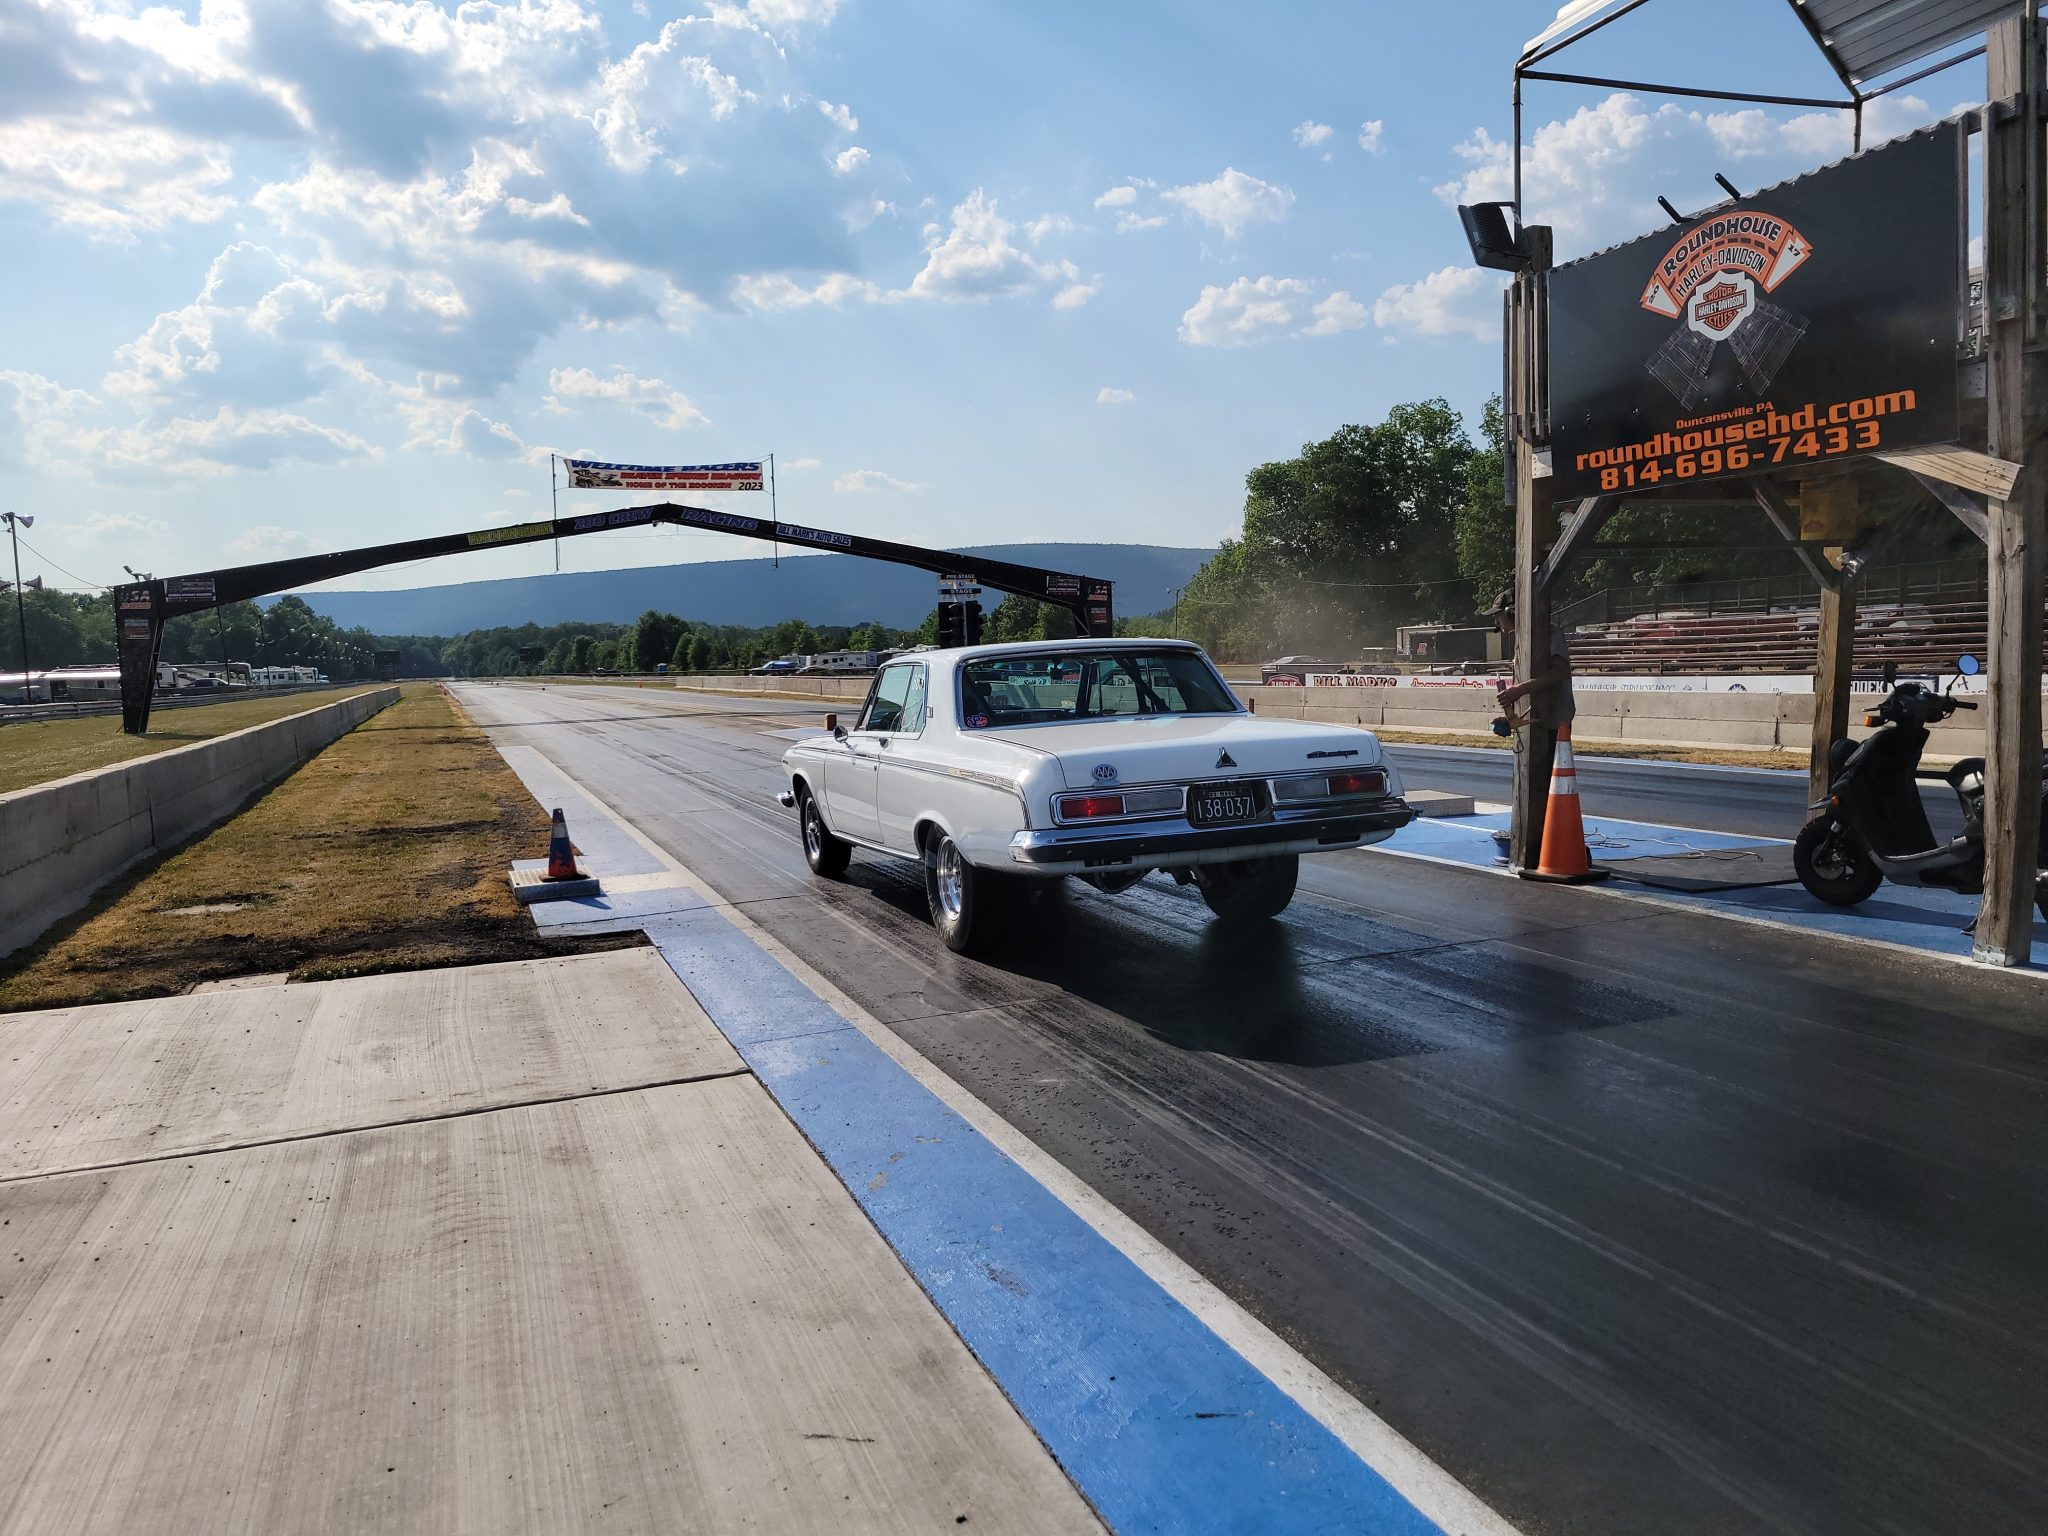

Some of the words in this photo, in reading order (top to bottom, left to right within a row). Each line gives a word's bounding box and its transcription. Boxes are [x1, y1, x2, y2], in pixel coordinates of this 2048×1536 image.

[1663, 216, 1782, 277] ROUNDHOUSE
[1675, 246, 1768, 298] HARLEY-DAVIDSON
[1698, 294, 1744, 317] HARLEY-DAVIDSON
[1708, 287, 1734, 301] MOTOR
[1708, 311, 1733, 328] CYCLES
[1675, 406, 1754, 430] Duncansville
[1756, 401, 1775, 415] PA
[1575, 388, 1916, 471] roundhousehd.com
[1600, 420, 1881, 491] 814-696-7433
[738, 481, 764, 491] 2023
[575, 515, 606, 530] ZOO
[608, 507, 655, 525] CREW
[681, 508, 759, 531] RACING
[814, 531, 832, 542] AUTO
[832, 534, 851, 546] SALES
[1097, 766, 1116, 778] AAA
